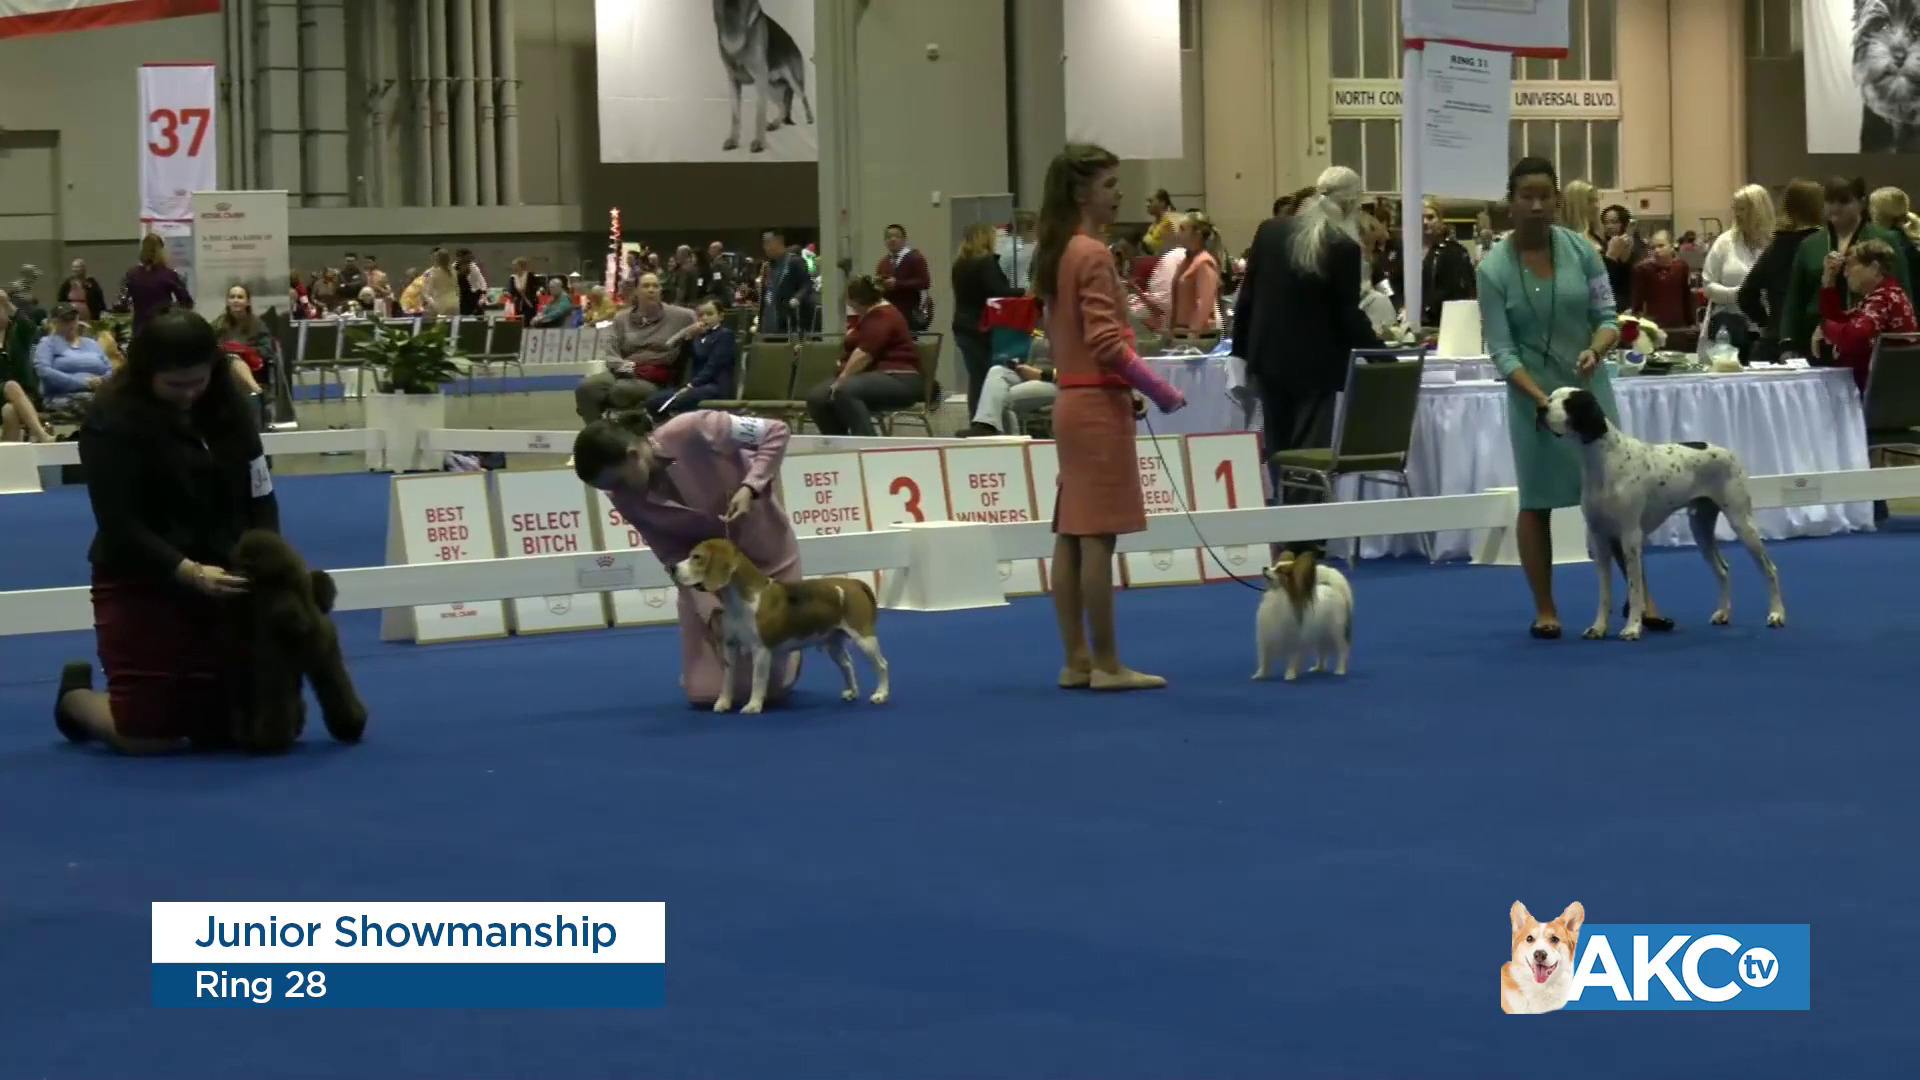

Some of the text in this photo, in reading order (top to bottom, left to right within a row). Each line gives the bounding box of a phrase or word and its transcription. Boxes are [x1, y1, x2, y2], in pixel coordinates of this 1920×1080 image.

[1336, 91, 1375, 105] NORTH
[1515, 92, 1580, 106] UNIVERSAL
[1584, 92, 1617, 106] BLVD.
[149, 108, 210, 157] 37
[1139, 456, 1163, 470] EST
[804, 472, 839, 487] BEST
[969, 473, 1006, 489] BEST
[1141, 474, 1157, 487] OF
[1215, 460, 1238, 509] 1
[816, 490, 832, 504] OF
[889, 476, 925, 523] 3
[981, 492, 999, 507] OF
[425, 506, 464, 523] BEST
[512, 511, 580, 532] SELECT
[793, 507, 861, 525] OPPOSITE
[956, 510, 1028, 523] WINNERS
[427, 526, 468, 542] BRED
[522, 534, 577, 554] BITCH
[435, 545, 467, 561] -BY-
